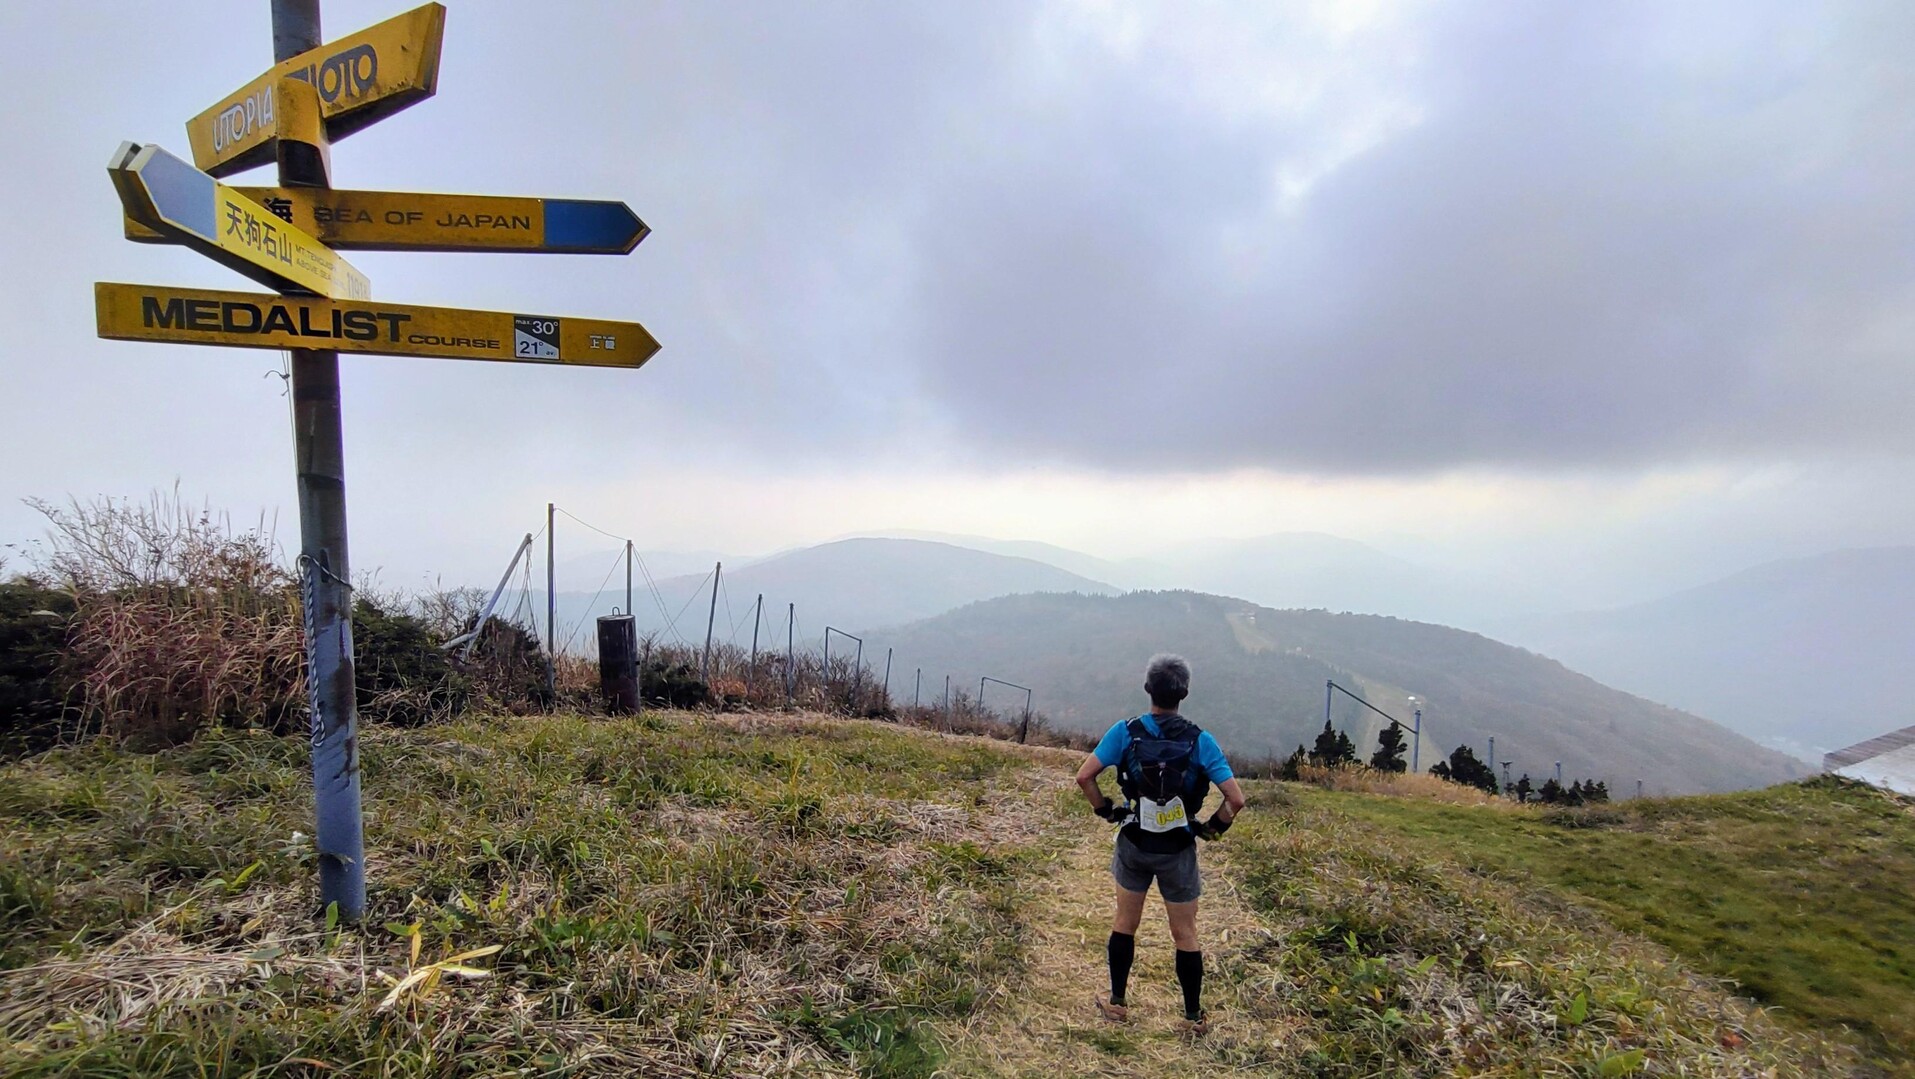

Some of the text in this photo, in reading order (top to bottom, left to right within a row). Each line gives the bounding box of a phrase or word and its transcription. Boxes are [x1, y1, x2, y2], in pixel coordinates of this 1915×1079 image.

[212, 86, 274, 153] UTOPIA
[225, 200, 293, 267] 天狗石山
[314, 206, 531, 230] SEA OF JAPAN
[142, 296, 501, 350] MEDALIST COURSE
